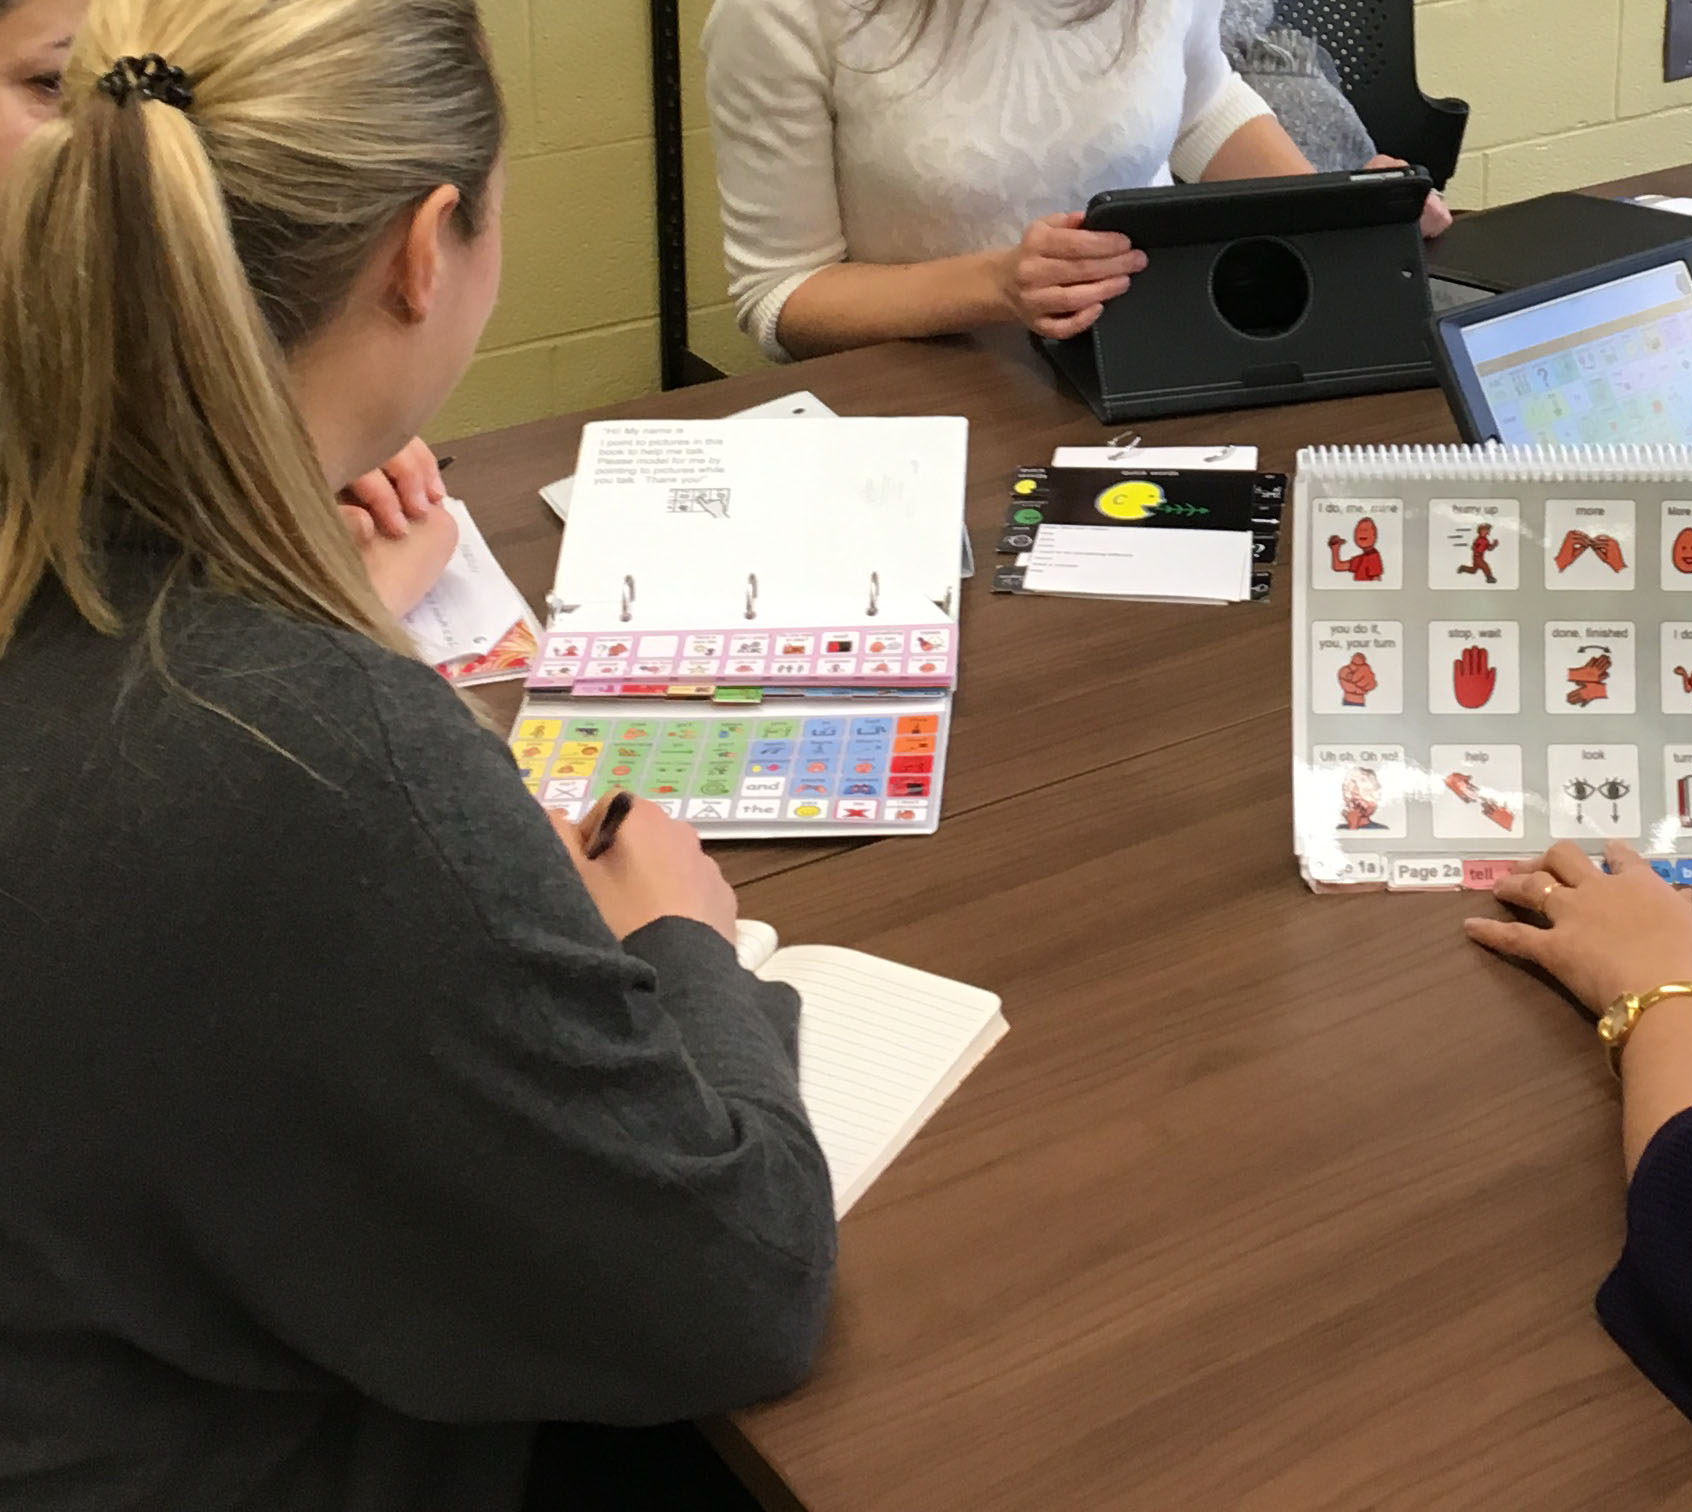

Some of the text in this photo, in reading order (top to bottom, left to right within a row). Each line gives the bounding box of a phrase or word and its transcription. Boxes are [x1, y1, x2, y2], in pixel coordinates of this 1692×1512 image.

[1575, 506, 1606, 516] more
[1667, 506, 1692, 516] More
[1330, 624, 1351, 635] you
[1353, 624, 1368, 634] do
[1465, 751, 1489, 763] help
[1581, 750, 1606, 760] look
[746, 782, 780, 791] and
[743, 805, 775, 814] the
[1399, 864, 1461, 880] Page 2a
[1469, 867, 1494, 881] tell
